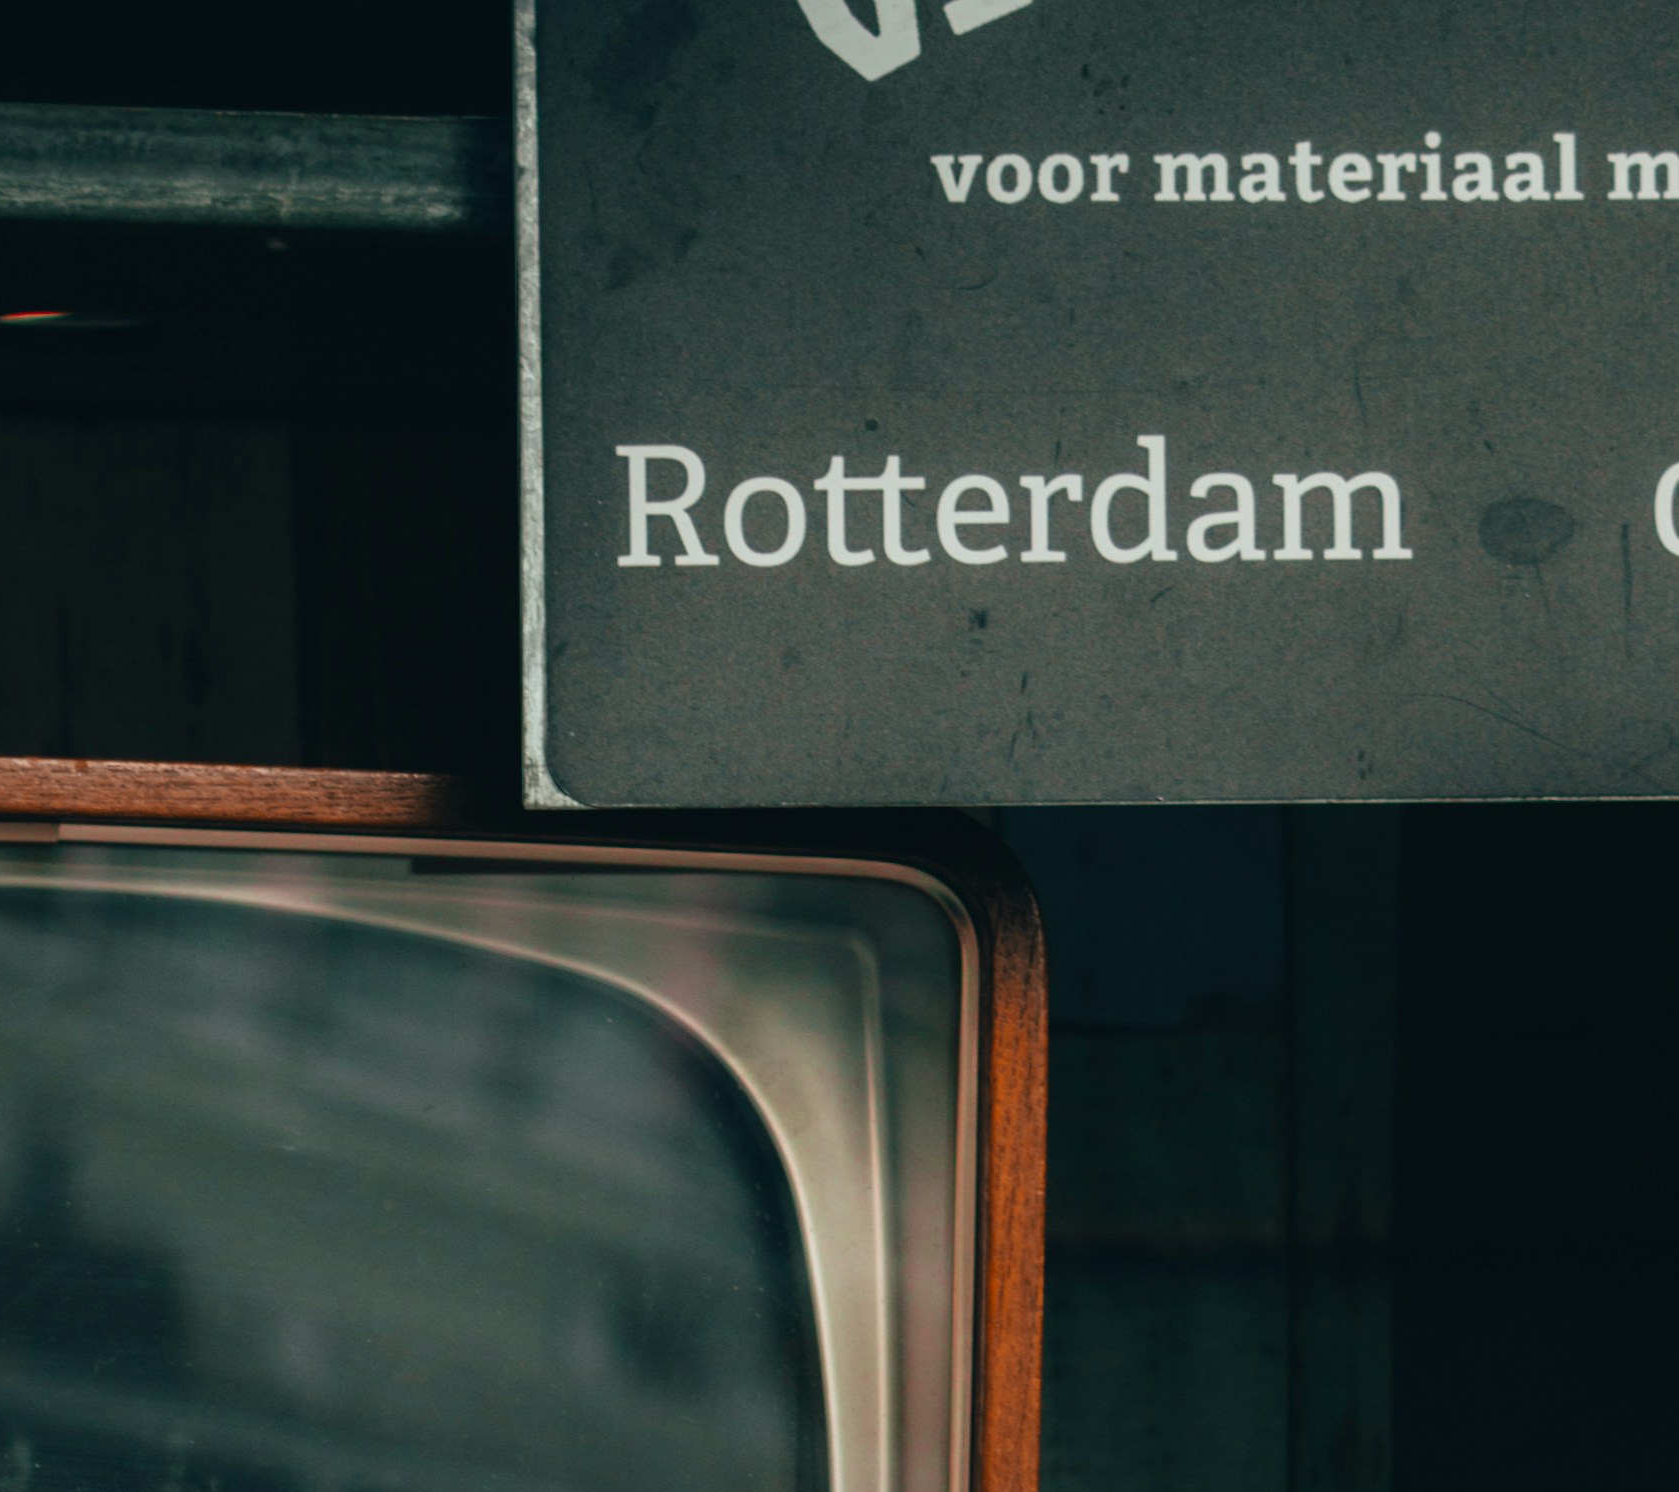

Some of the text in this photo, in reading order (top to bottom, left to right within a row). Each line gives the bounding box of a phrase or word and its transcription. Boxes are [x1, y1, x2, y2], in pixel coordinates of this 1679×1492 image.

[930, 153, 1130, 204] voor
[1153, 131, 1585, 204] materiaal
[615, 434, 1413, 567] Rotterdam
